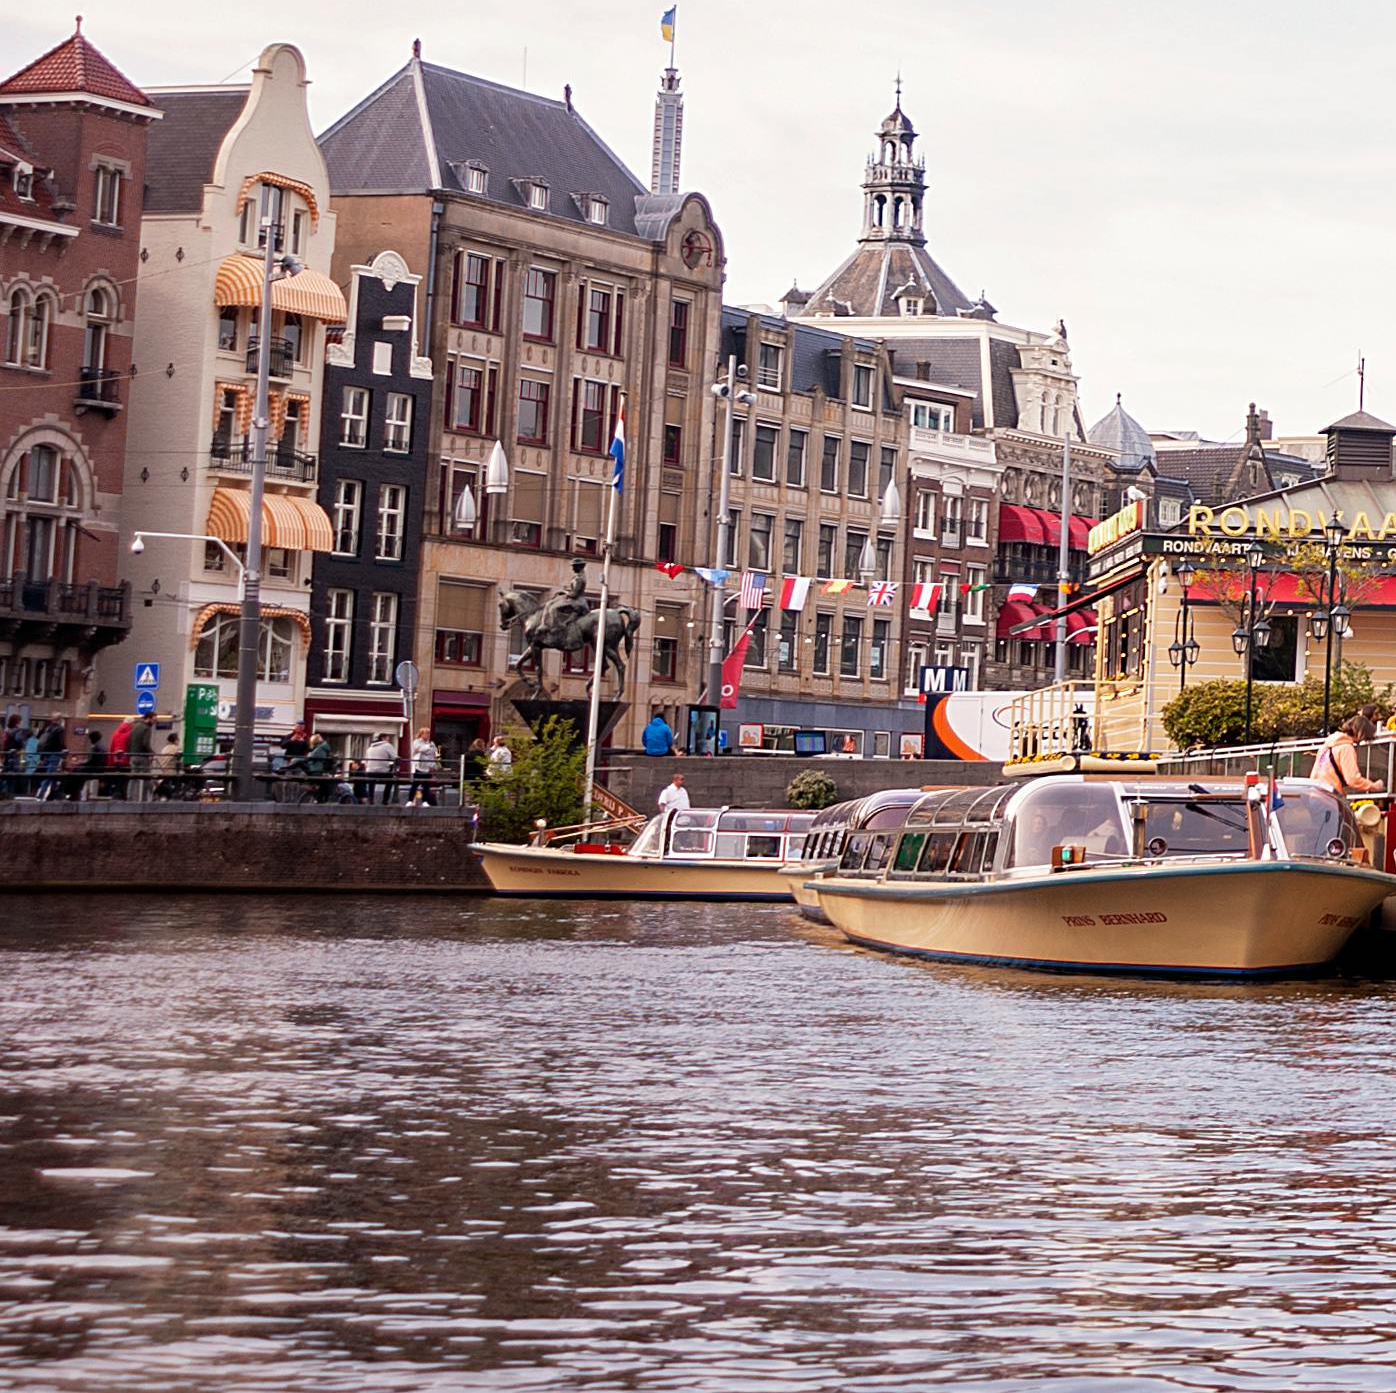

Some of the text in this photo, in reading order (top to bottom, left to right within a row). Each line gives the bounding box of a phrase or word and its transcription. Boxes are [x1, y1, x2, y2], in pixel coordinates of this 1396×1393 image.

[924, 668, 946, 692] M
[953, 669, 967, 692] M
[1061, 911, 1168, 927] PRINS BERNHARD
